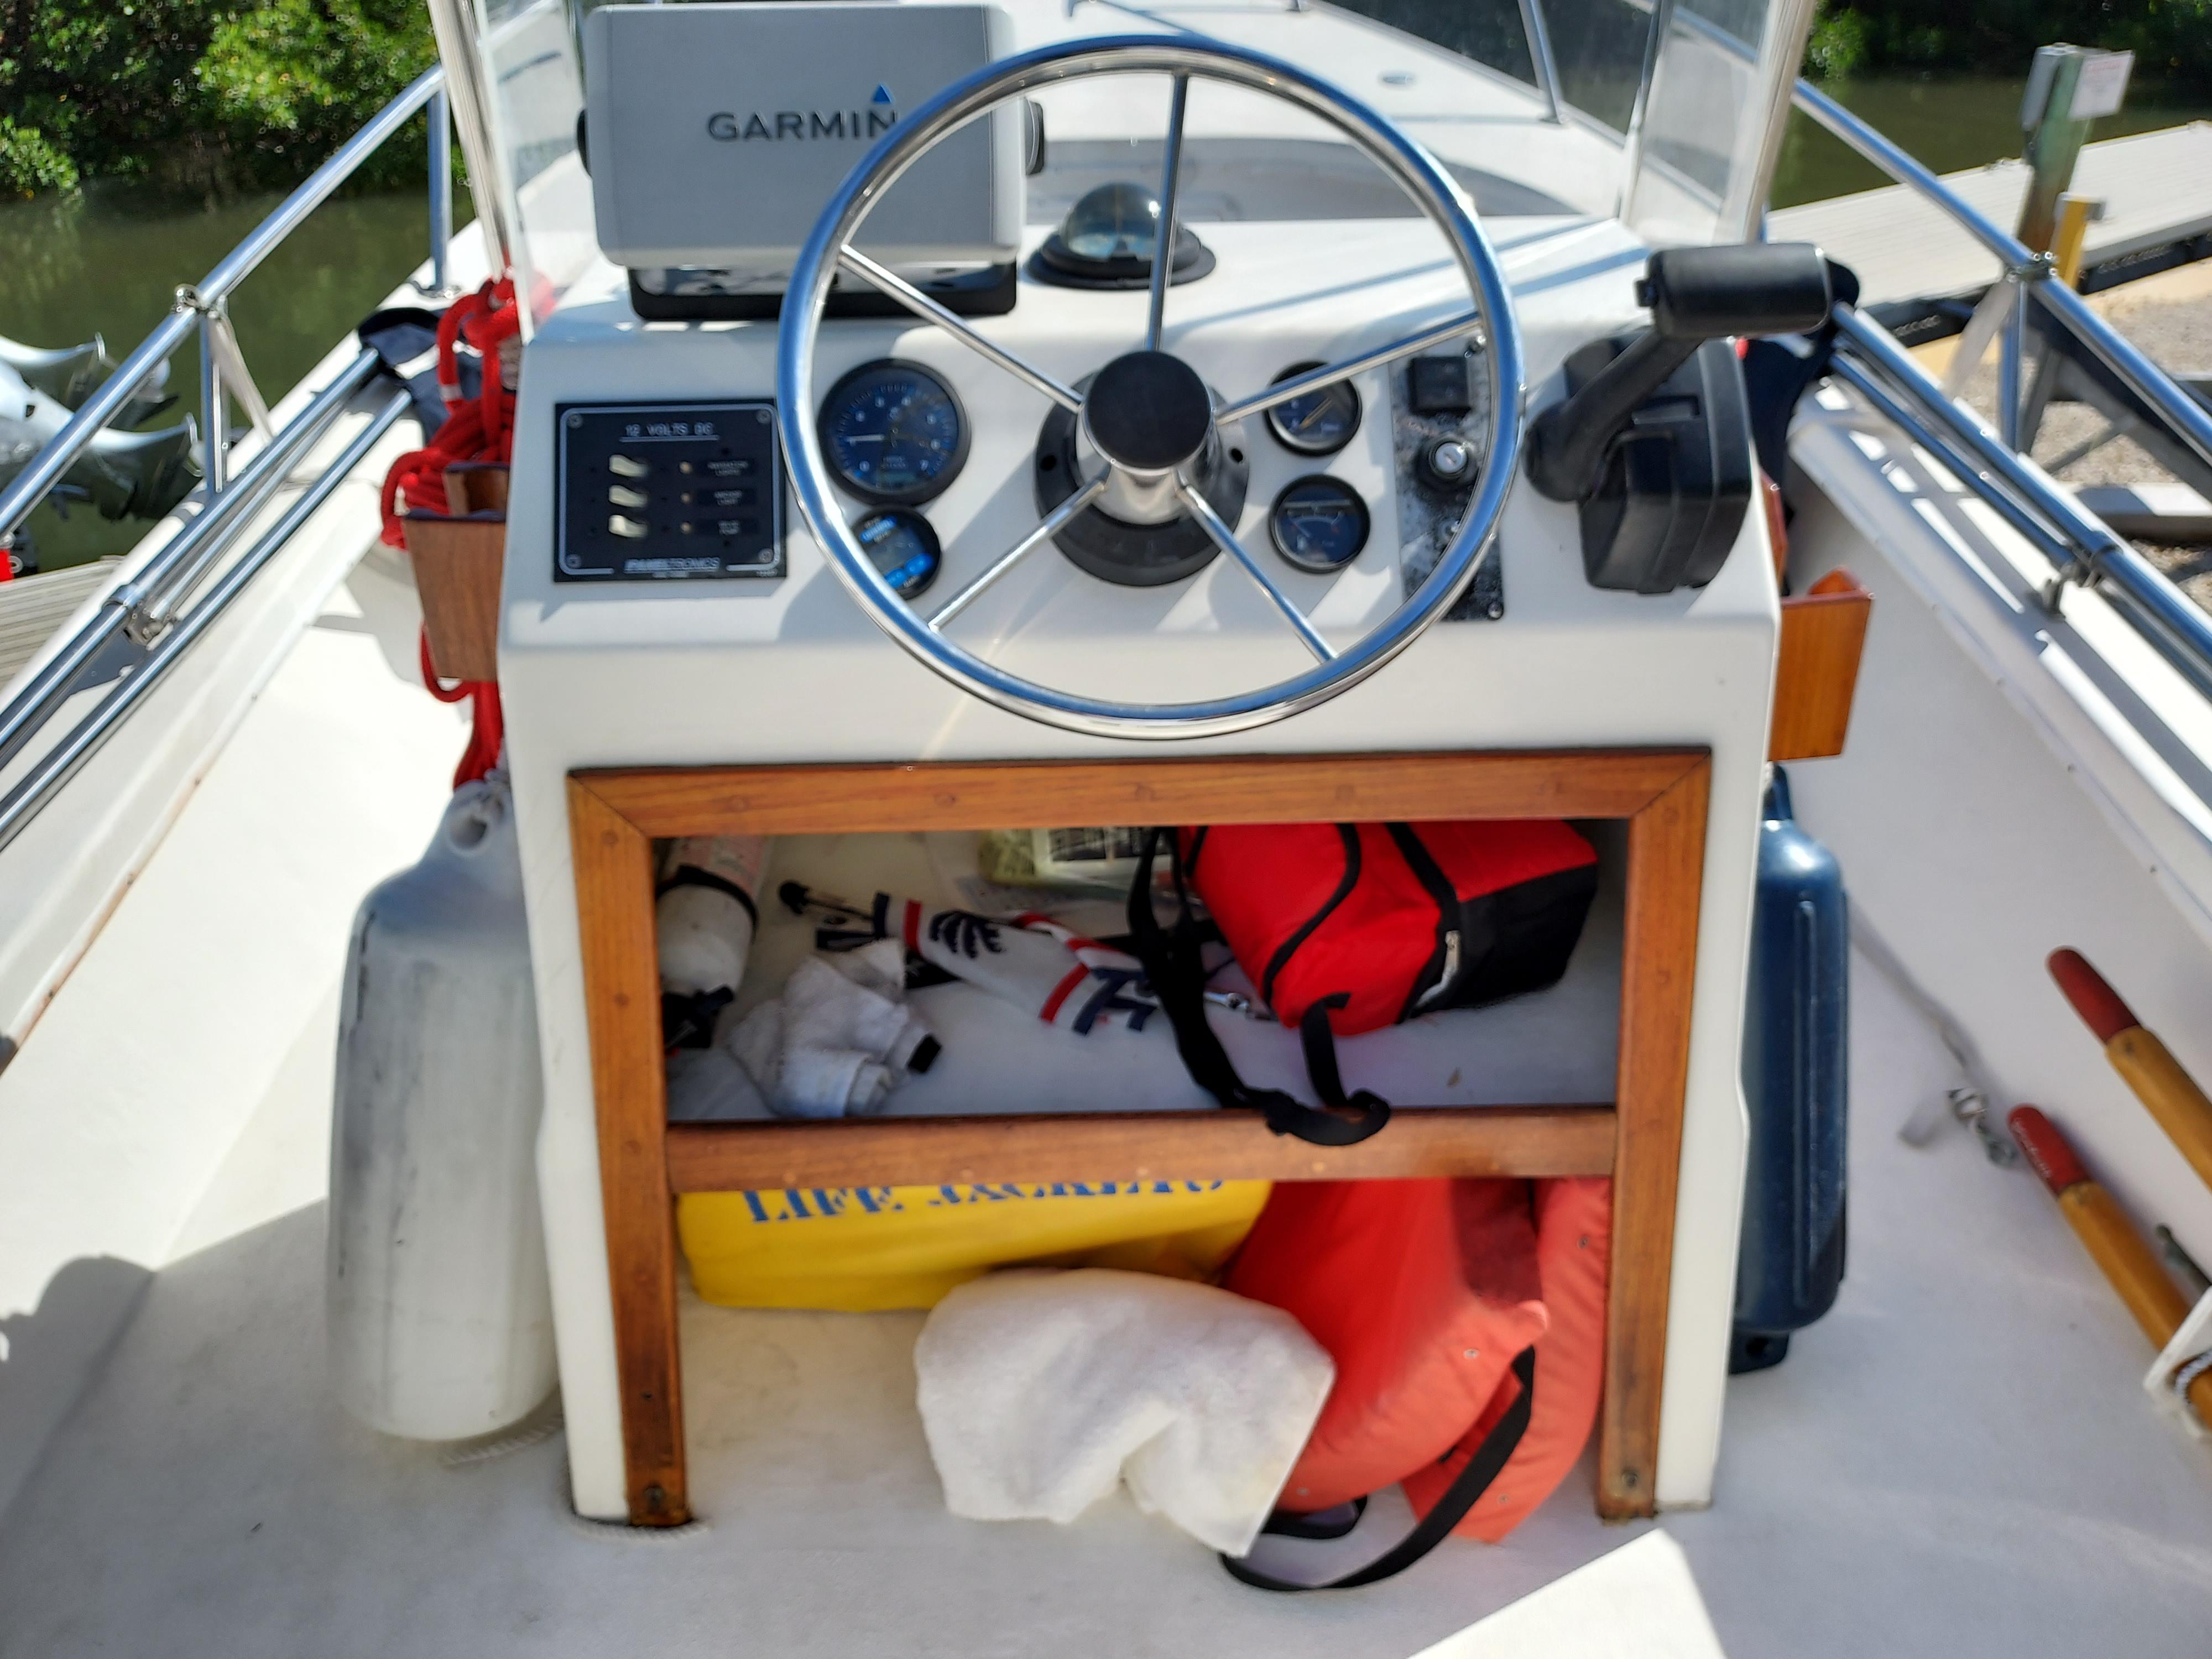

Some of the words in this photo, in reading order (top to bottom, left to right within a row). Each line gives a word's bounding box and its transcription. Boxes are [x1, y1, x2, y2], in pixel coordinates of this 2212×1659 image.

[708, 111, 898, 141] GARMIN
[646, 422, 689, 436] VOLTS
[742, 1186, 904, 1222] LIFE
